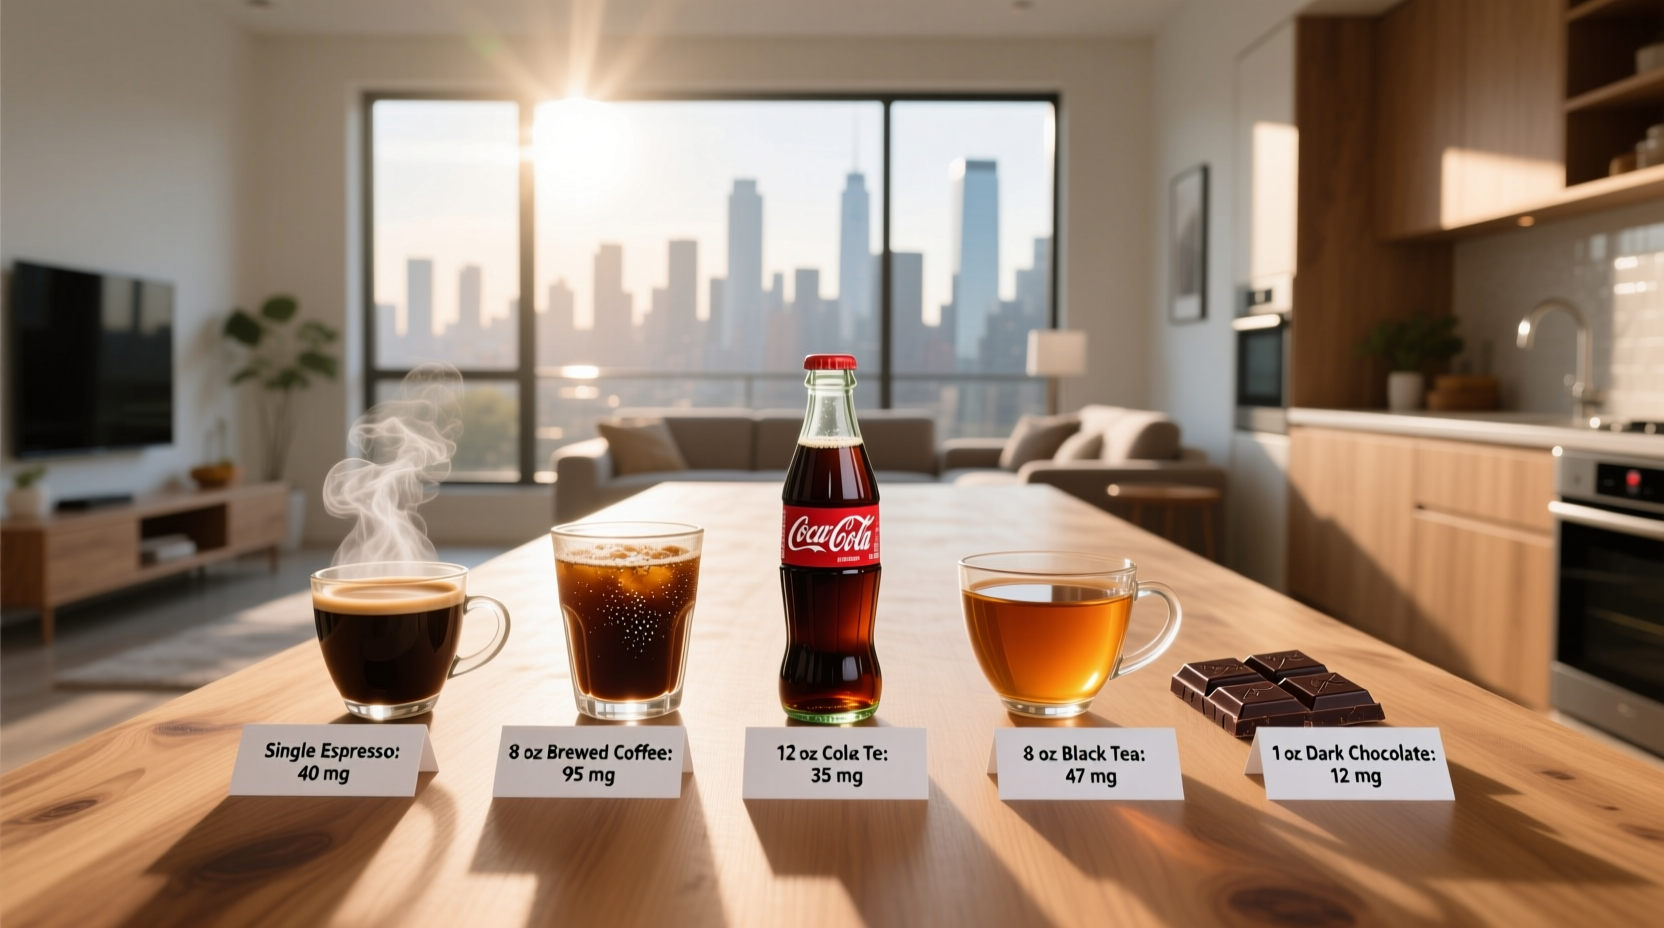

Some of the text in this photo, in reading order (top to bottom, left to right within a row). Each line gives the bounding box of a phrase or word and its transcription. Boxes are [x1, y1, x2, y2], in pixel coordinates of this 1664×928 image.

[264, 741, 400, 763] Single Espresso:
[508, 743, 673, 762] 8 oz Brewed Coffee:
[776, 743, 796, 761] 12
[799, 749, 818, 761] oz
[862, 744, 888, 762] Te:
[1023, 744, 1146, 762] 8 oz Black Tea:
[1272, 743, 1436, 762] 1 oz Dark Chocolate:
[297, 764, 351, 786] 40 mg
[562, 765, 616, 787] 95 mg
[811, 767, 863, 787] 35 mg
[1065, 767, 1117, 787] 47 mg
[1330, 767, 1382, 787] 12 mg
